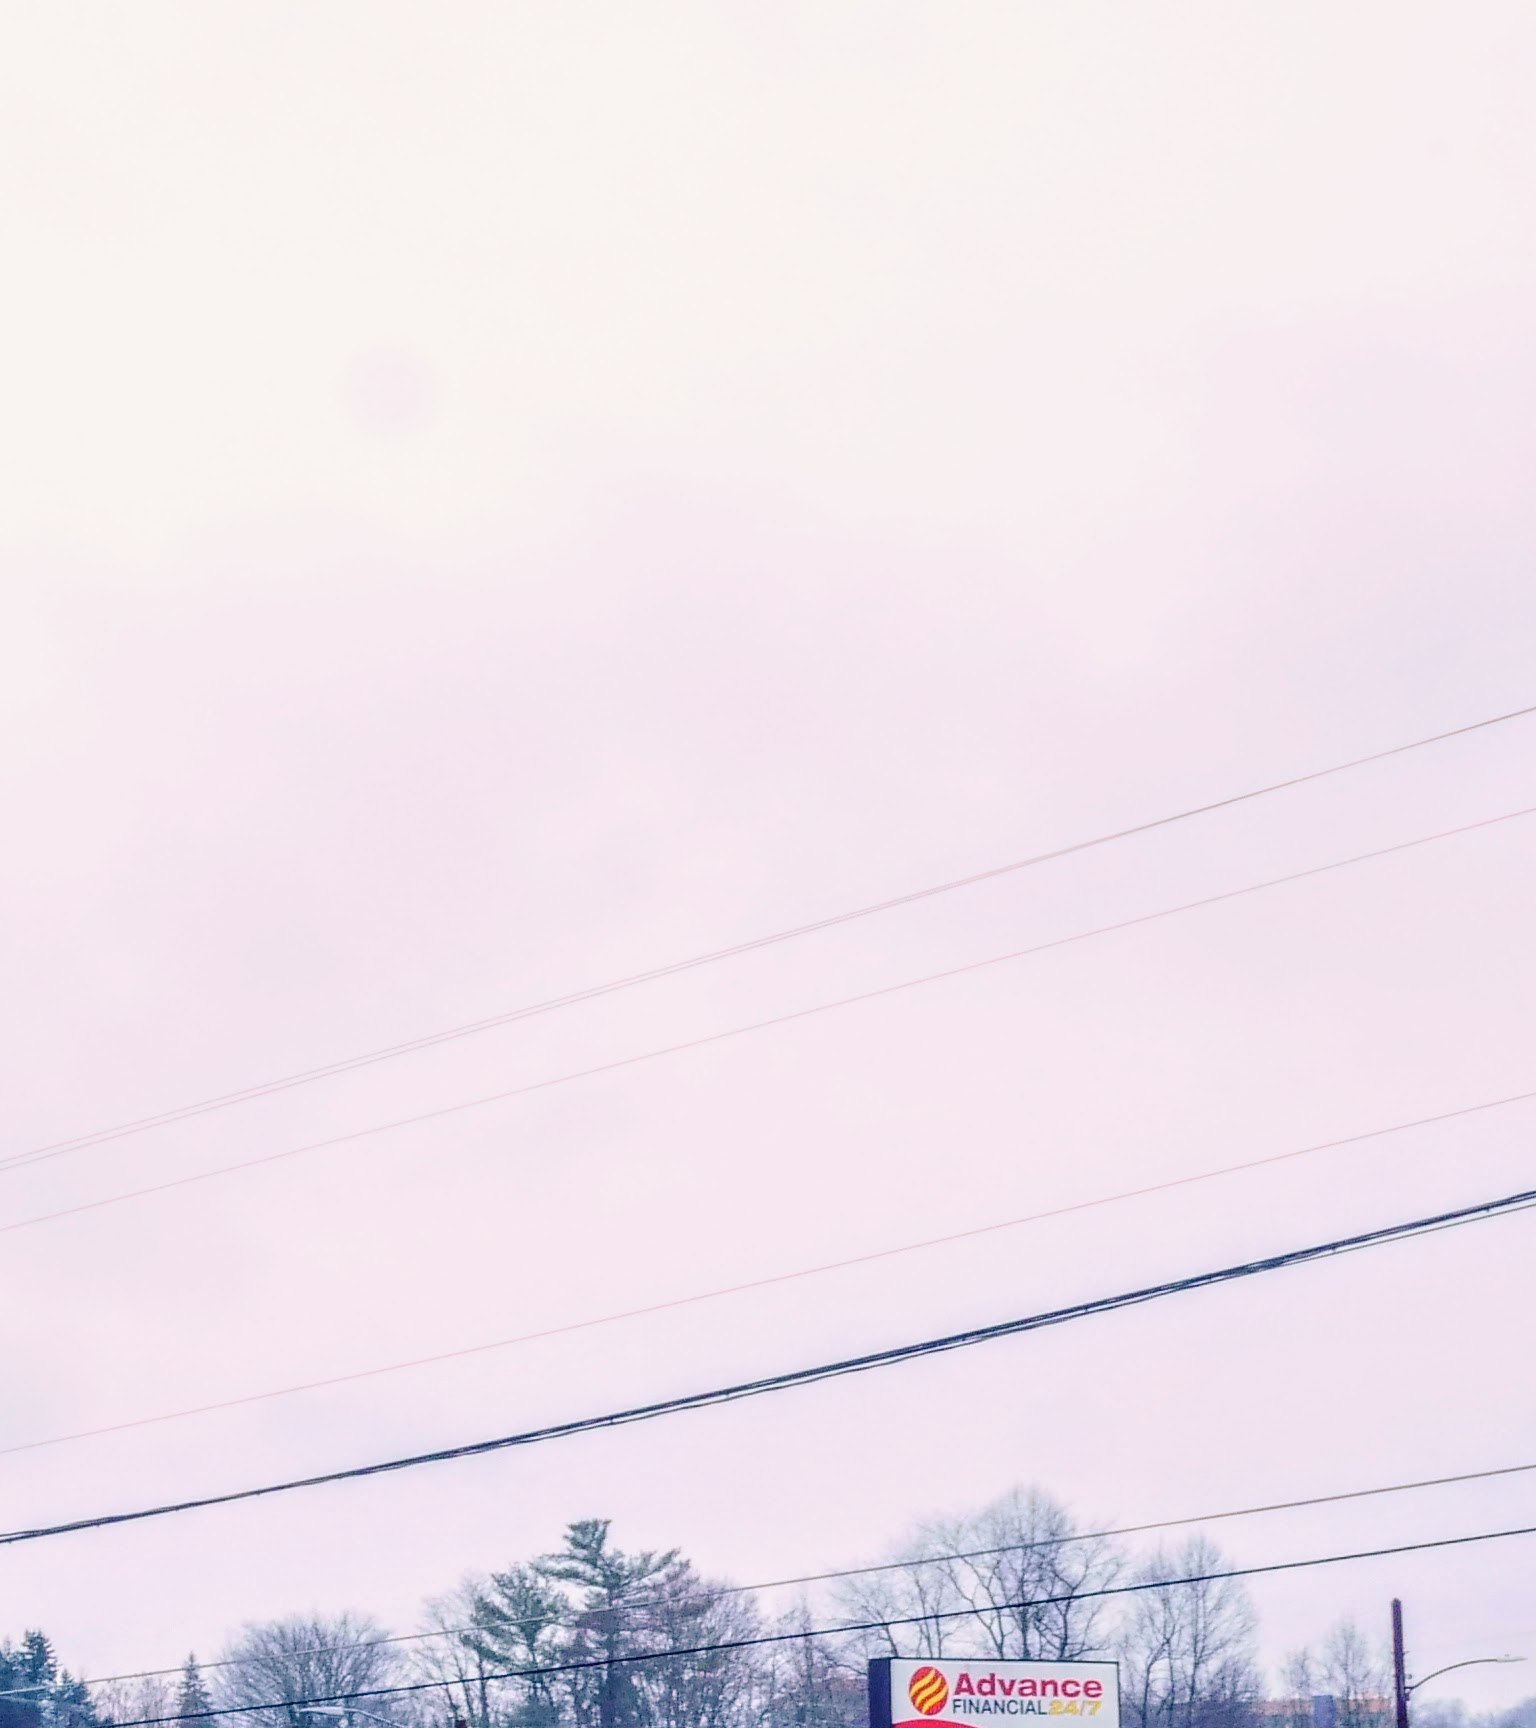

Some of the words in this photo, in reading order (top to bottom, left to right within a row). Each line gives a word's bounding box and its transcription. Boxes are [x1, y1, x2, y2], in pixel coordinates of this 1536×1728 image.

[954, 1672, 1103, 1698] Advance
[952, 1698, 1048, 1715] FINANCIAL
[1048, 1700, 1102, 1716] 24/7
